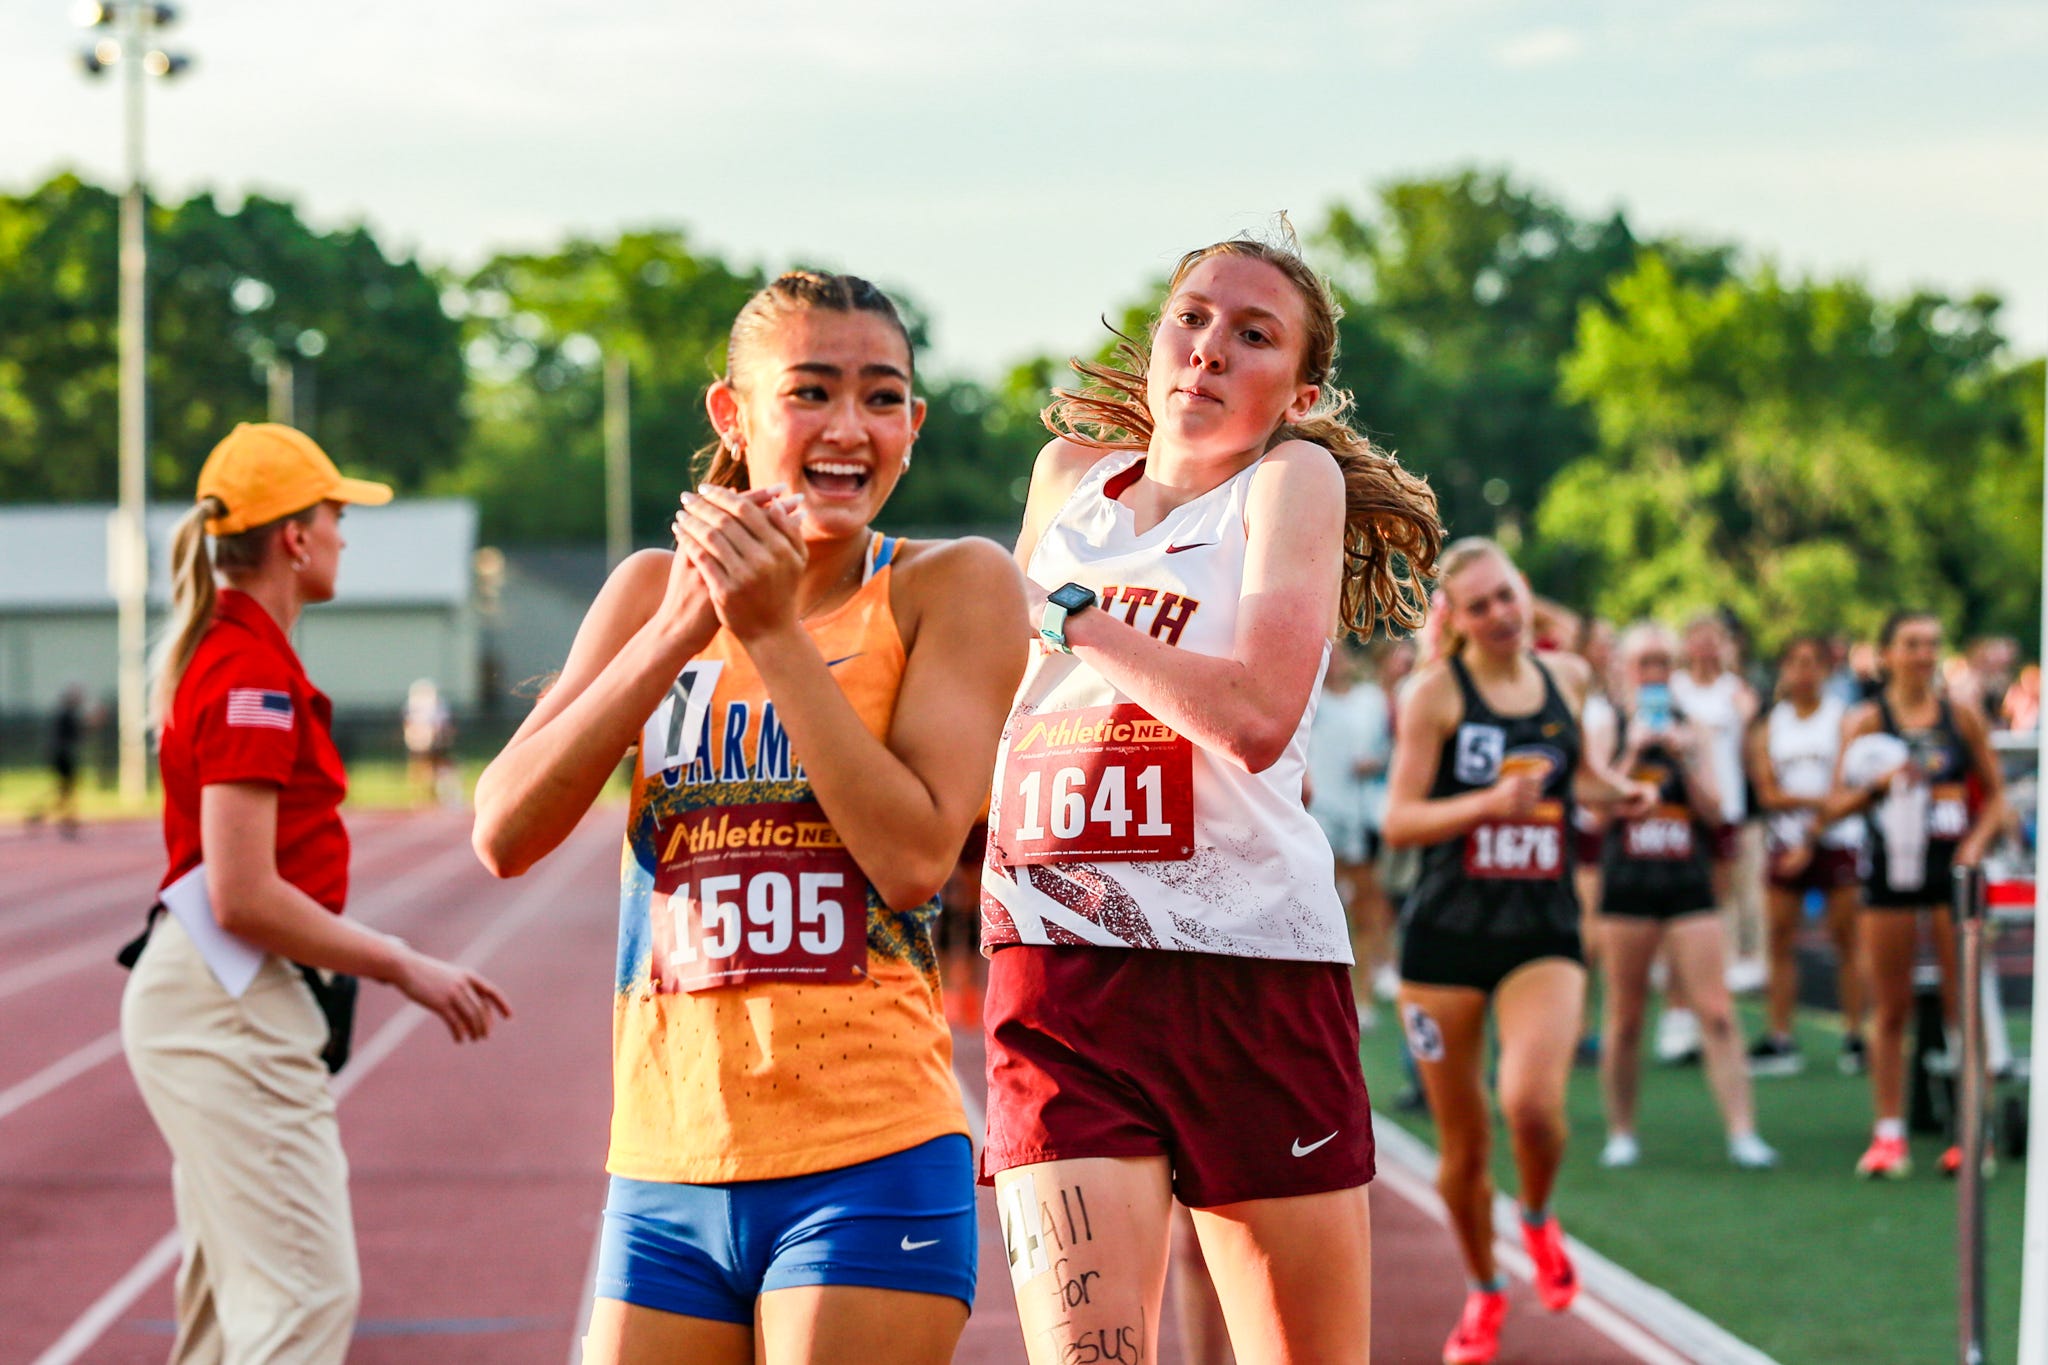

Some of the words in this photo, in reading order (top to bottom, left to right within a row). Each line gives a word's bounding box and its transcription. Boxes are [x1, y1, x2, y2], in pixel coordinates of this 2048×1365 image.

[1466, 735, 1494, 779] 5
[1015, 765, 1172, 841] 1641
[660, 813, 795, 864] Athletic
[666, 871, 845, 966] 1595
[1041, 1185, 1093, 1251] All
[1051, 1258, 1100, 1313] for
